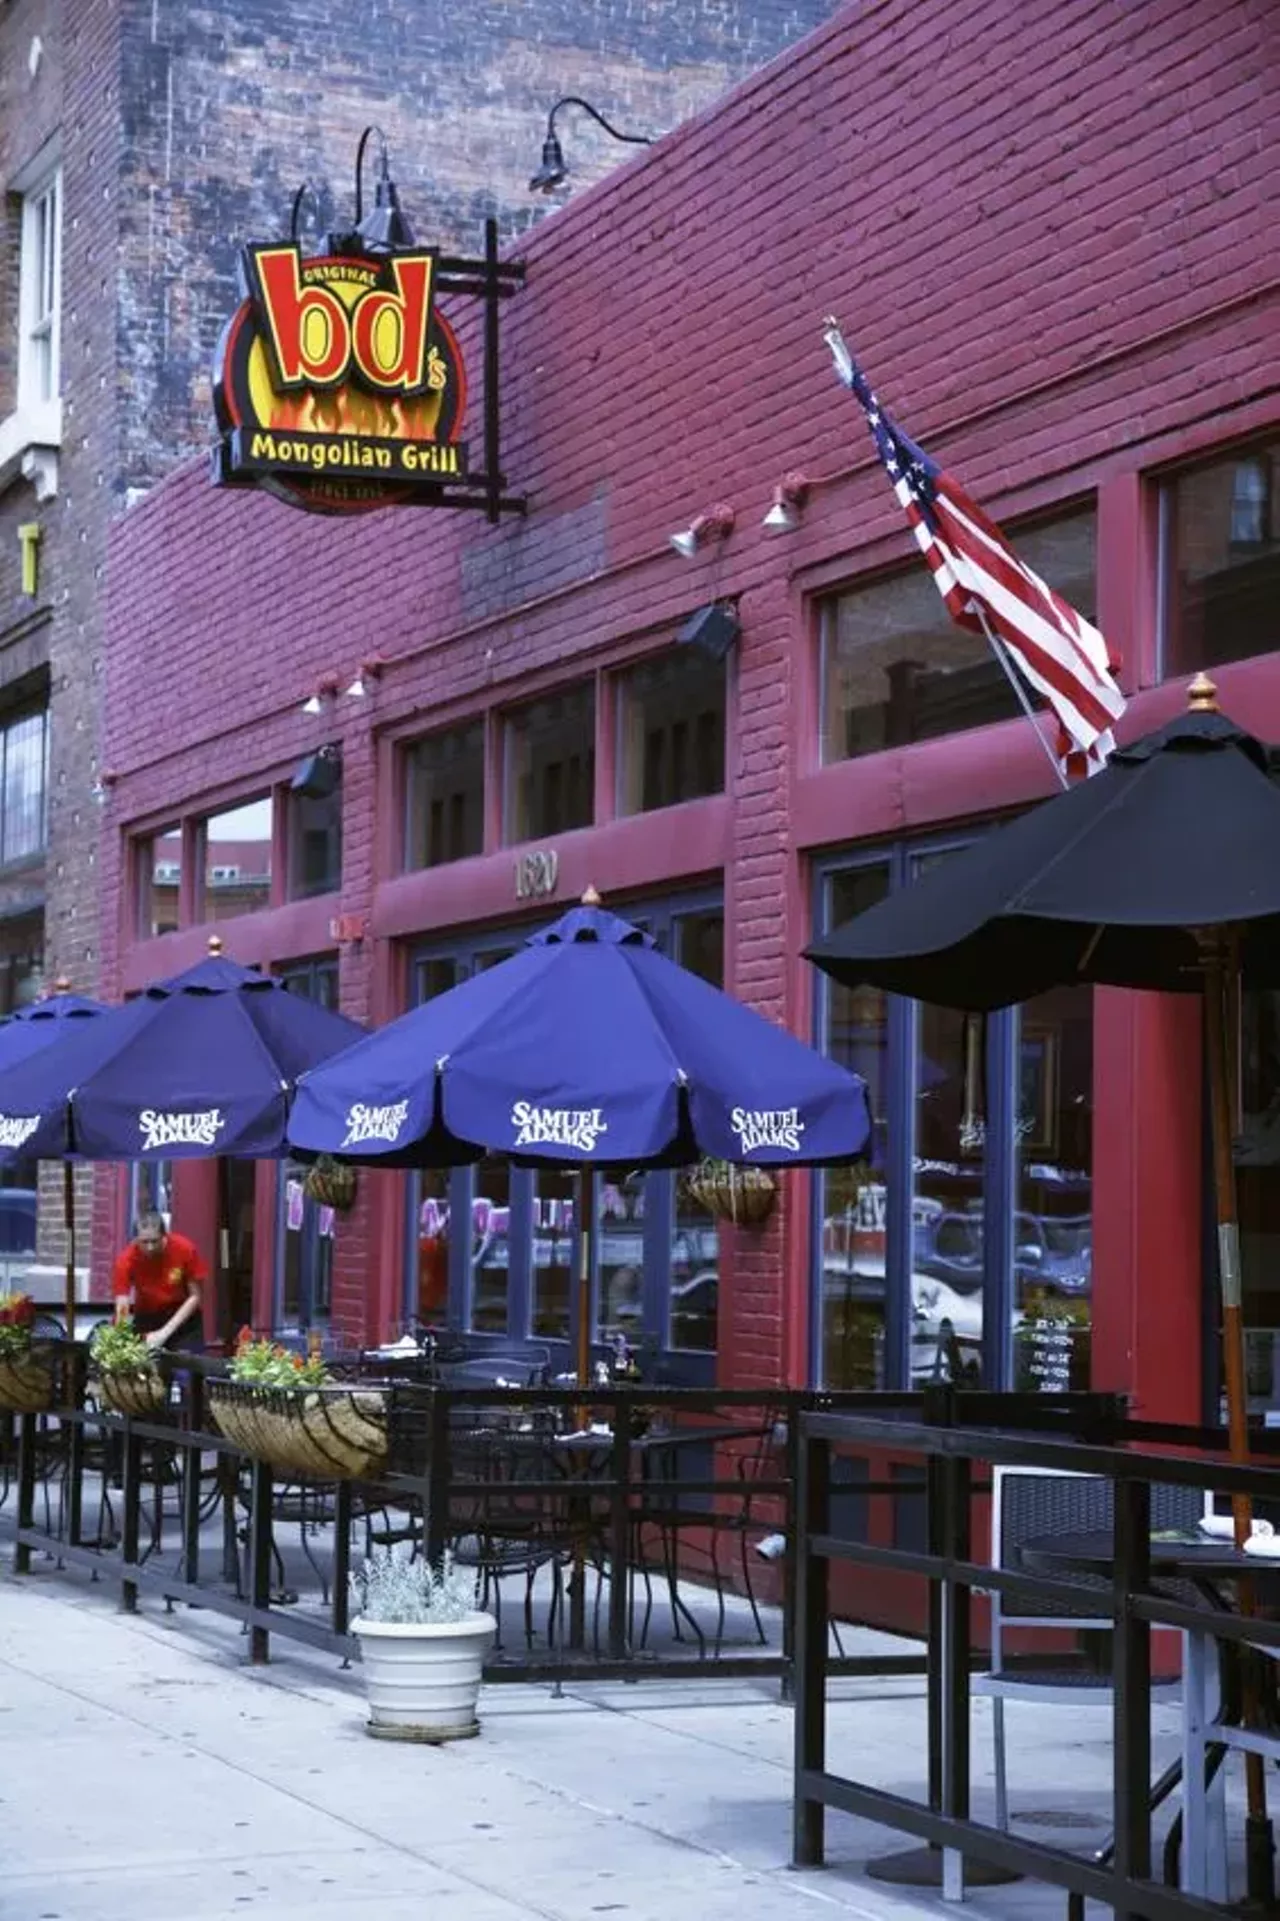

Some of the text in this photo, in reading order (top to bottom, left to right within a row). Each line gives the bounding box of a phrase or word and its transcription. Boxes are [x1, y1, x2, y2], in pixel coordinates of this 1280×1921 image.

[304, 266, 377, 287] ORIGINAL
[251, 434, 458, 473] Mongolian Grill
[138, 1108, 225, 1133] SAMUEL
[345, 1098, 409, 1122] SAMUEL
[510, 1100, 607, 1130] SAMUEL
[731, 1106, 805, 1133] SAMUEL
[141, 1123, 217, 1151] ADAMS
[340, 1118, 401, 1148] ADAMS
[513, 1123, 598, 1152] ADAMS
[741, 1126, 800, 1155] ADAMS
